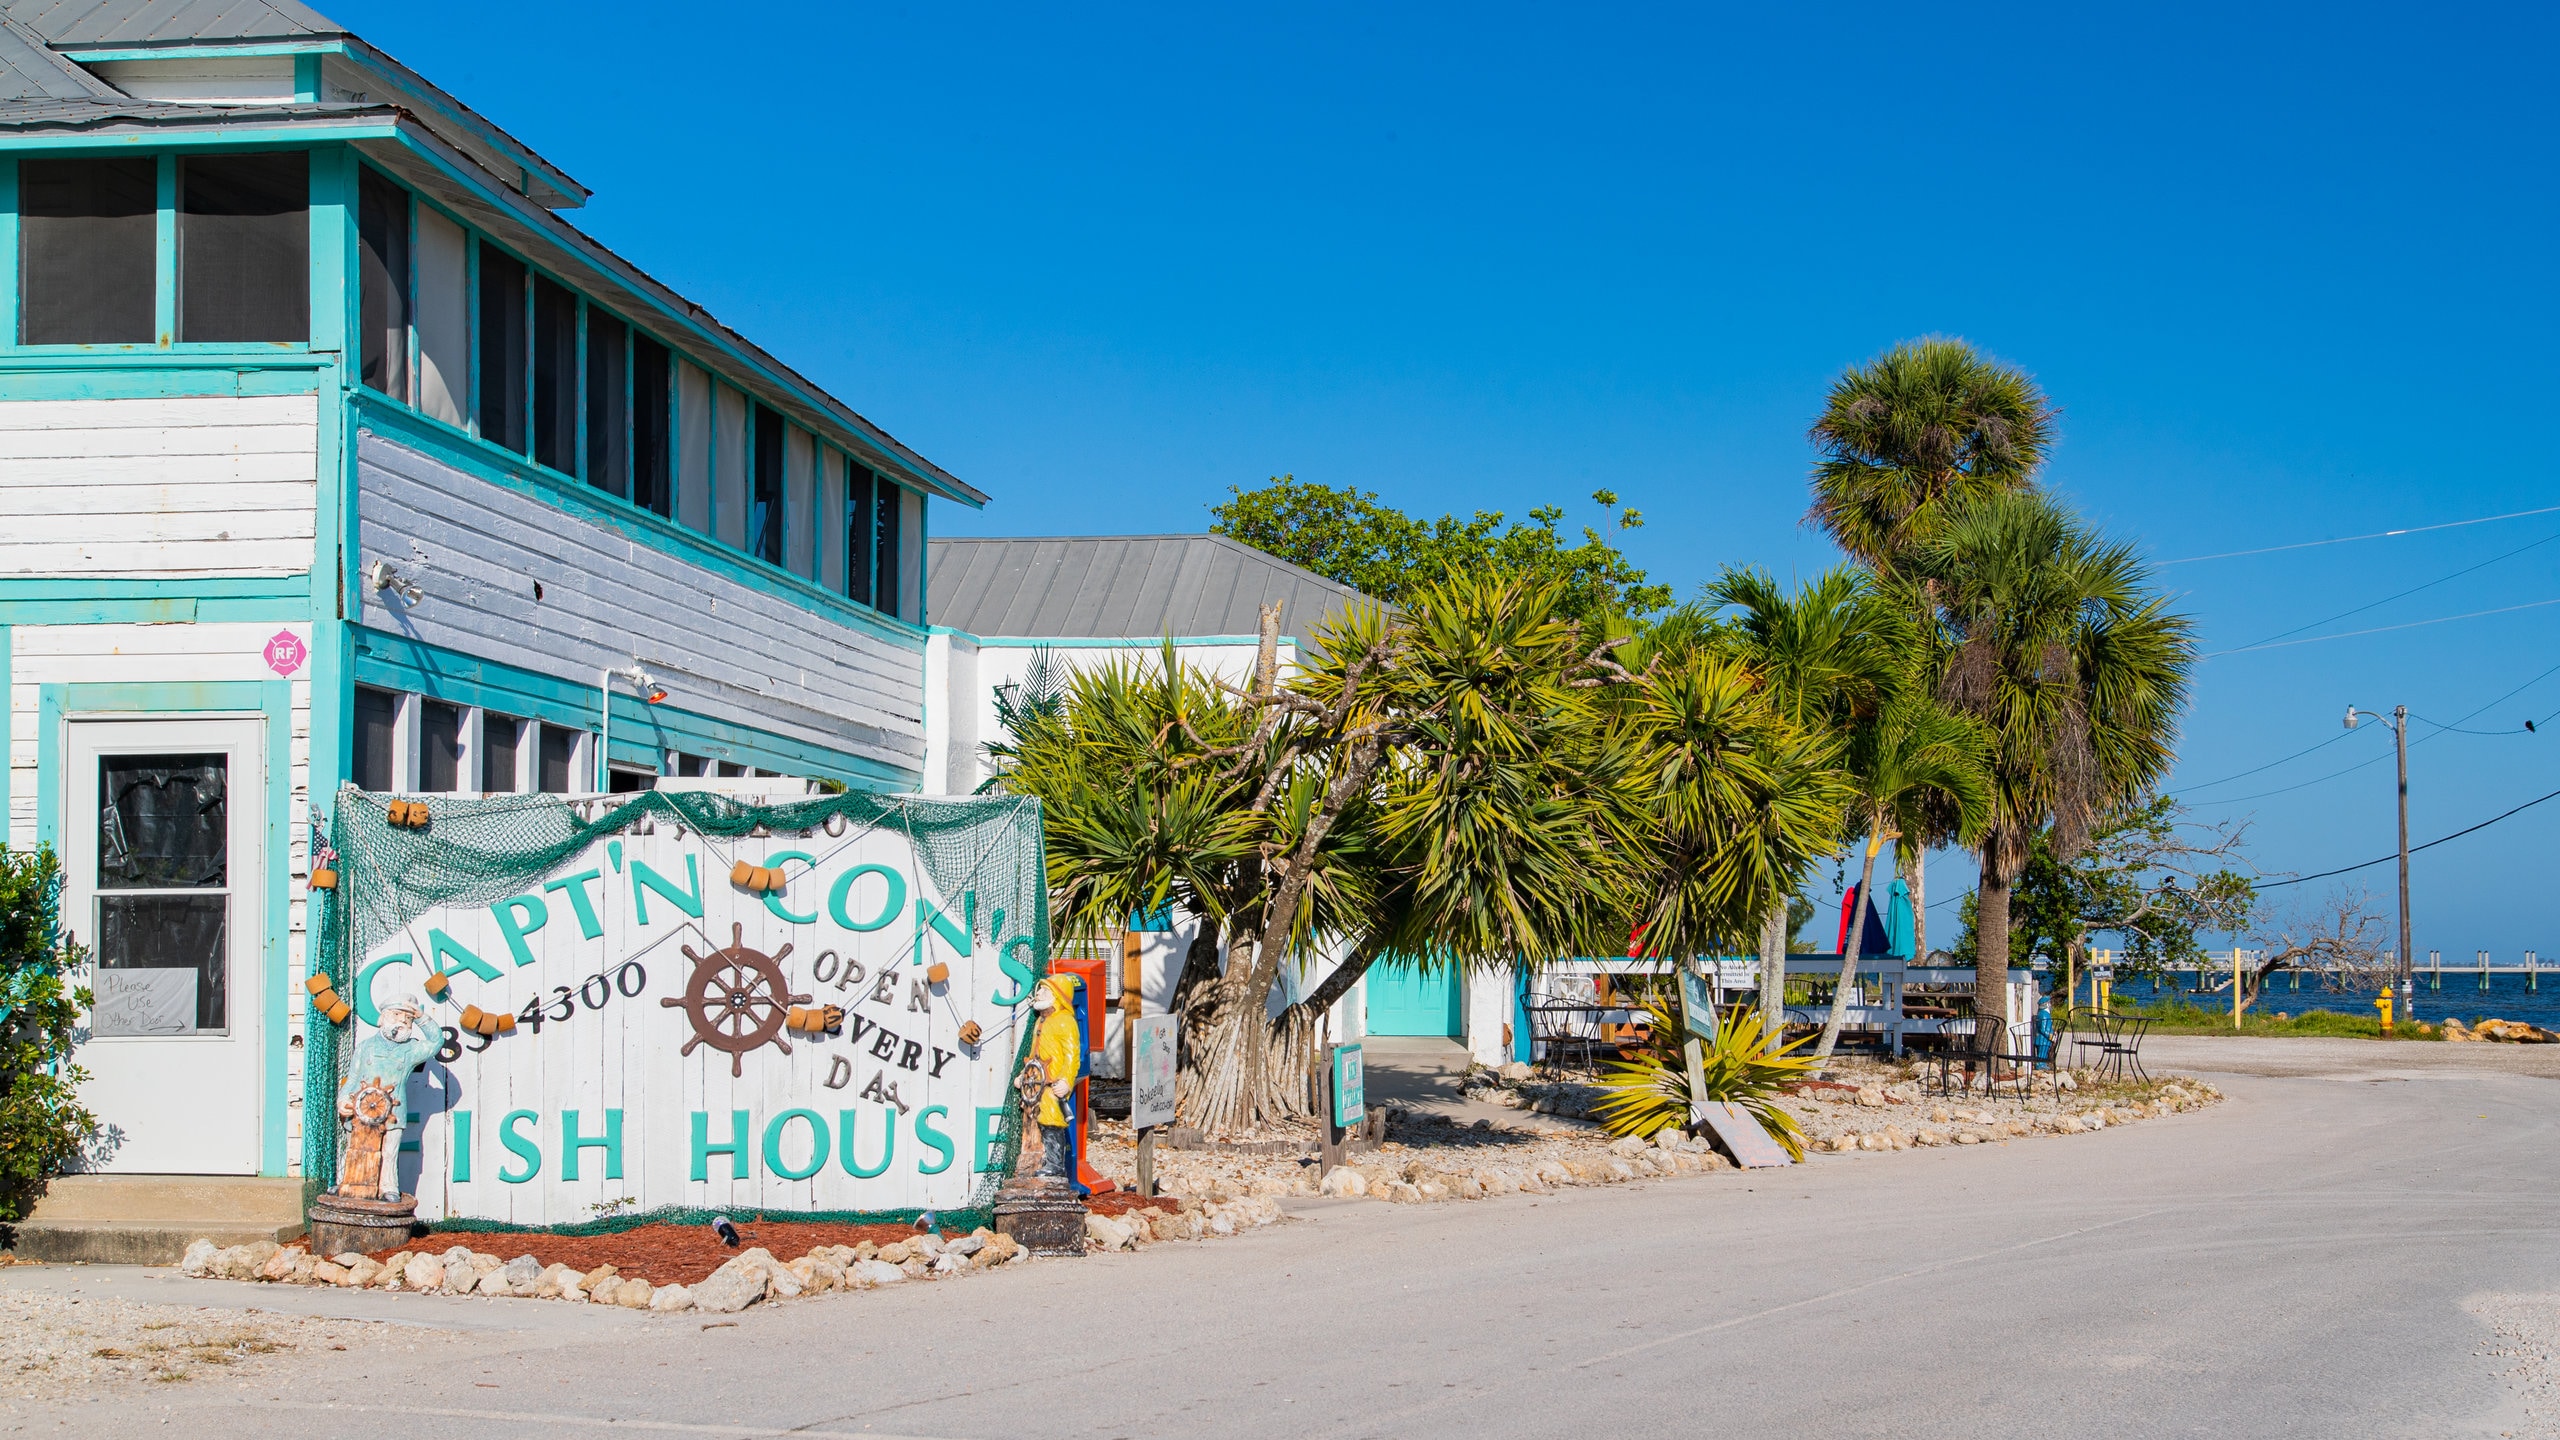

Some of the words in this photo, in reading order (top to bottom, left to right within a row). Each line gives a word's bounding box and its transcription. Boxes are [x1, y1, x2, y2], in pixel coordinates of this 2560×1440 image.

[275, 647, 295, 659] RF
[355, 840, 704, 1028] CAPT'N
[759, 850, 1036, 1006] CON'S
[104, 973, 153, 994] Please
[517, 961, 647, 1034] 4300
[813, 949, 931, 1014] OPEN
[101, 1012, 135, 1029] Other
[137, 1010, 165, 1028] Door
[825, 1004, 956, 1079] VERY
[823, 1053, 910, 1116] DAY
[690, 1104, 1008, 1182] HOUSE
